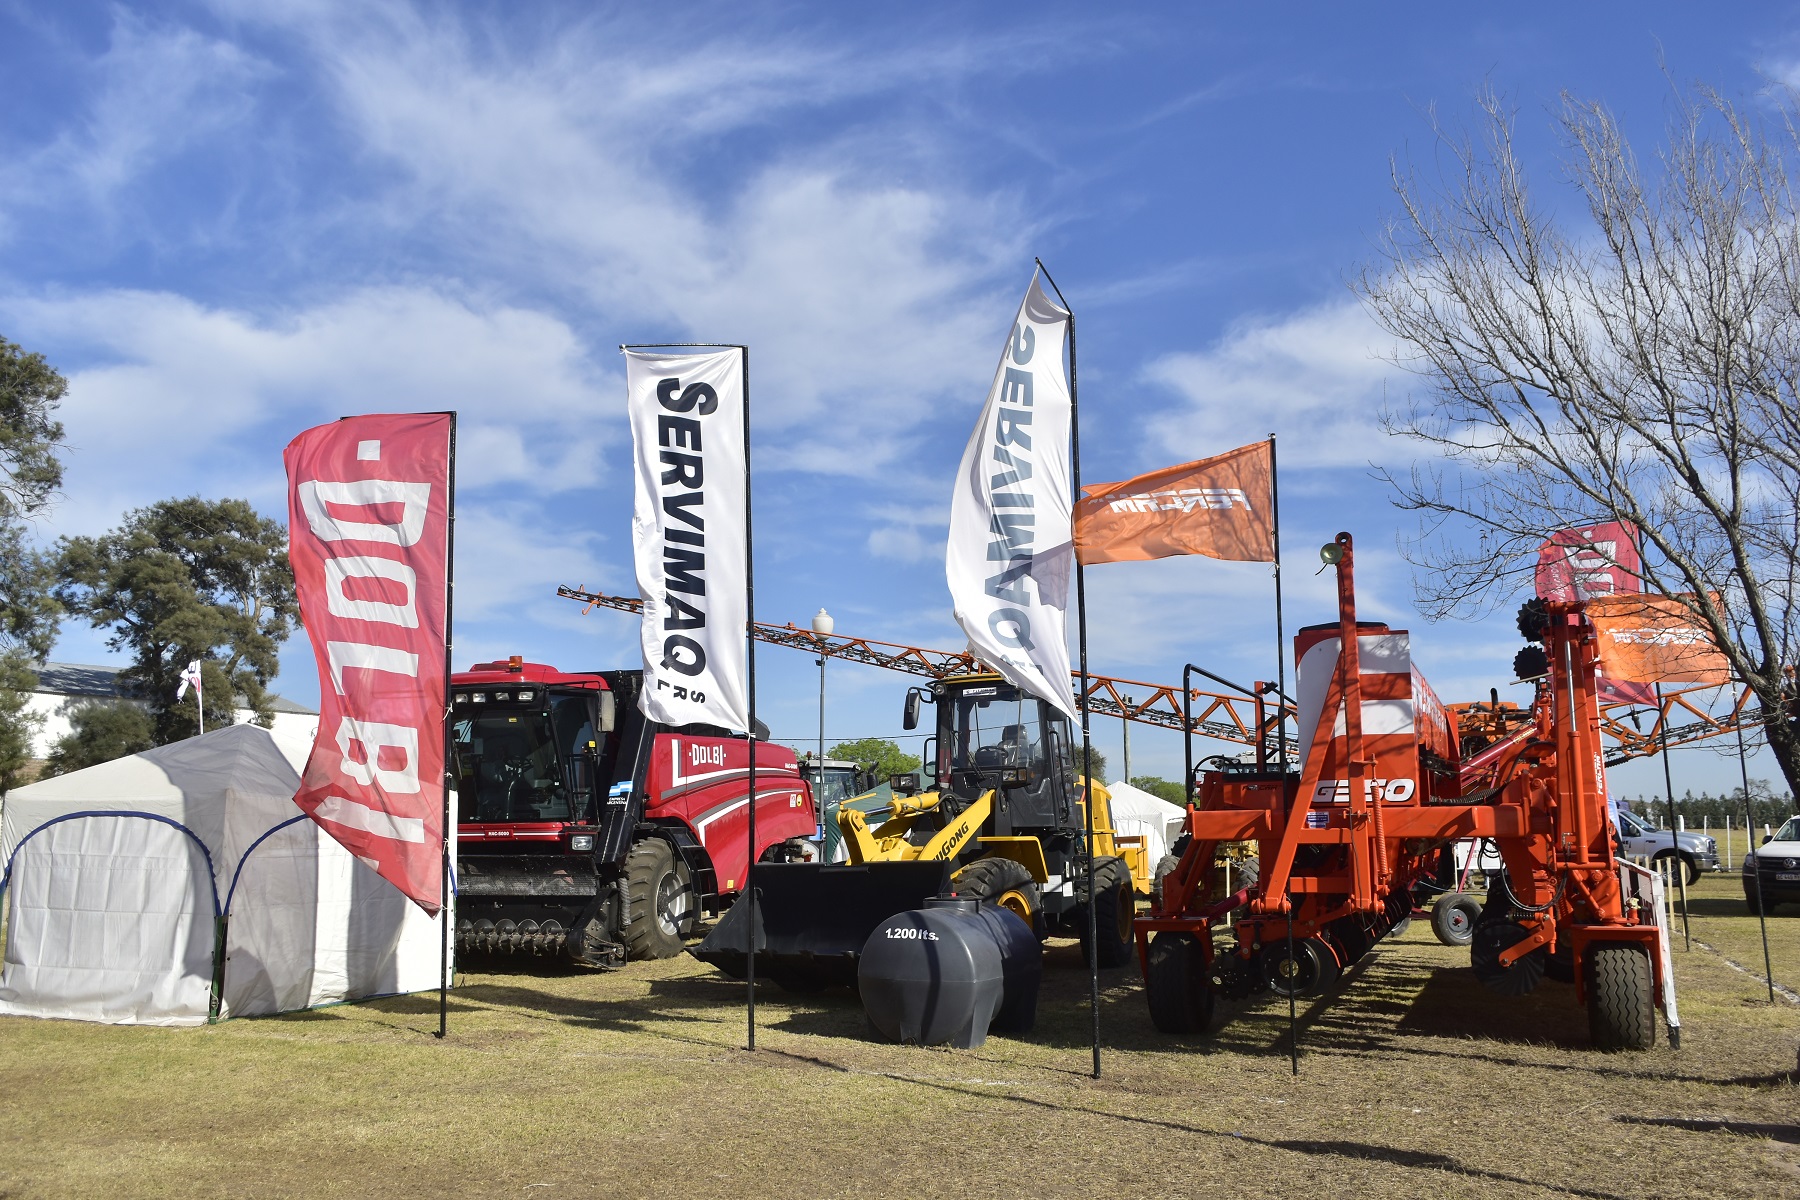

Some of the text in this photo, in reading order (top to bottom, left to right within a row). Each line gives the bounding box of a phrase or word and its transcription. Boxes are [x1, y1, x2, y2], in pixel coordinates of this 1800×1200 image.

[657, 377, 718, 678] SERVIMAQ
[691, 743, 724, 767] DOLBI
[885, 927, 940, 941] 1.200 lts.
